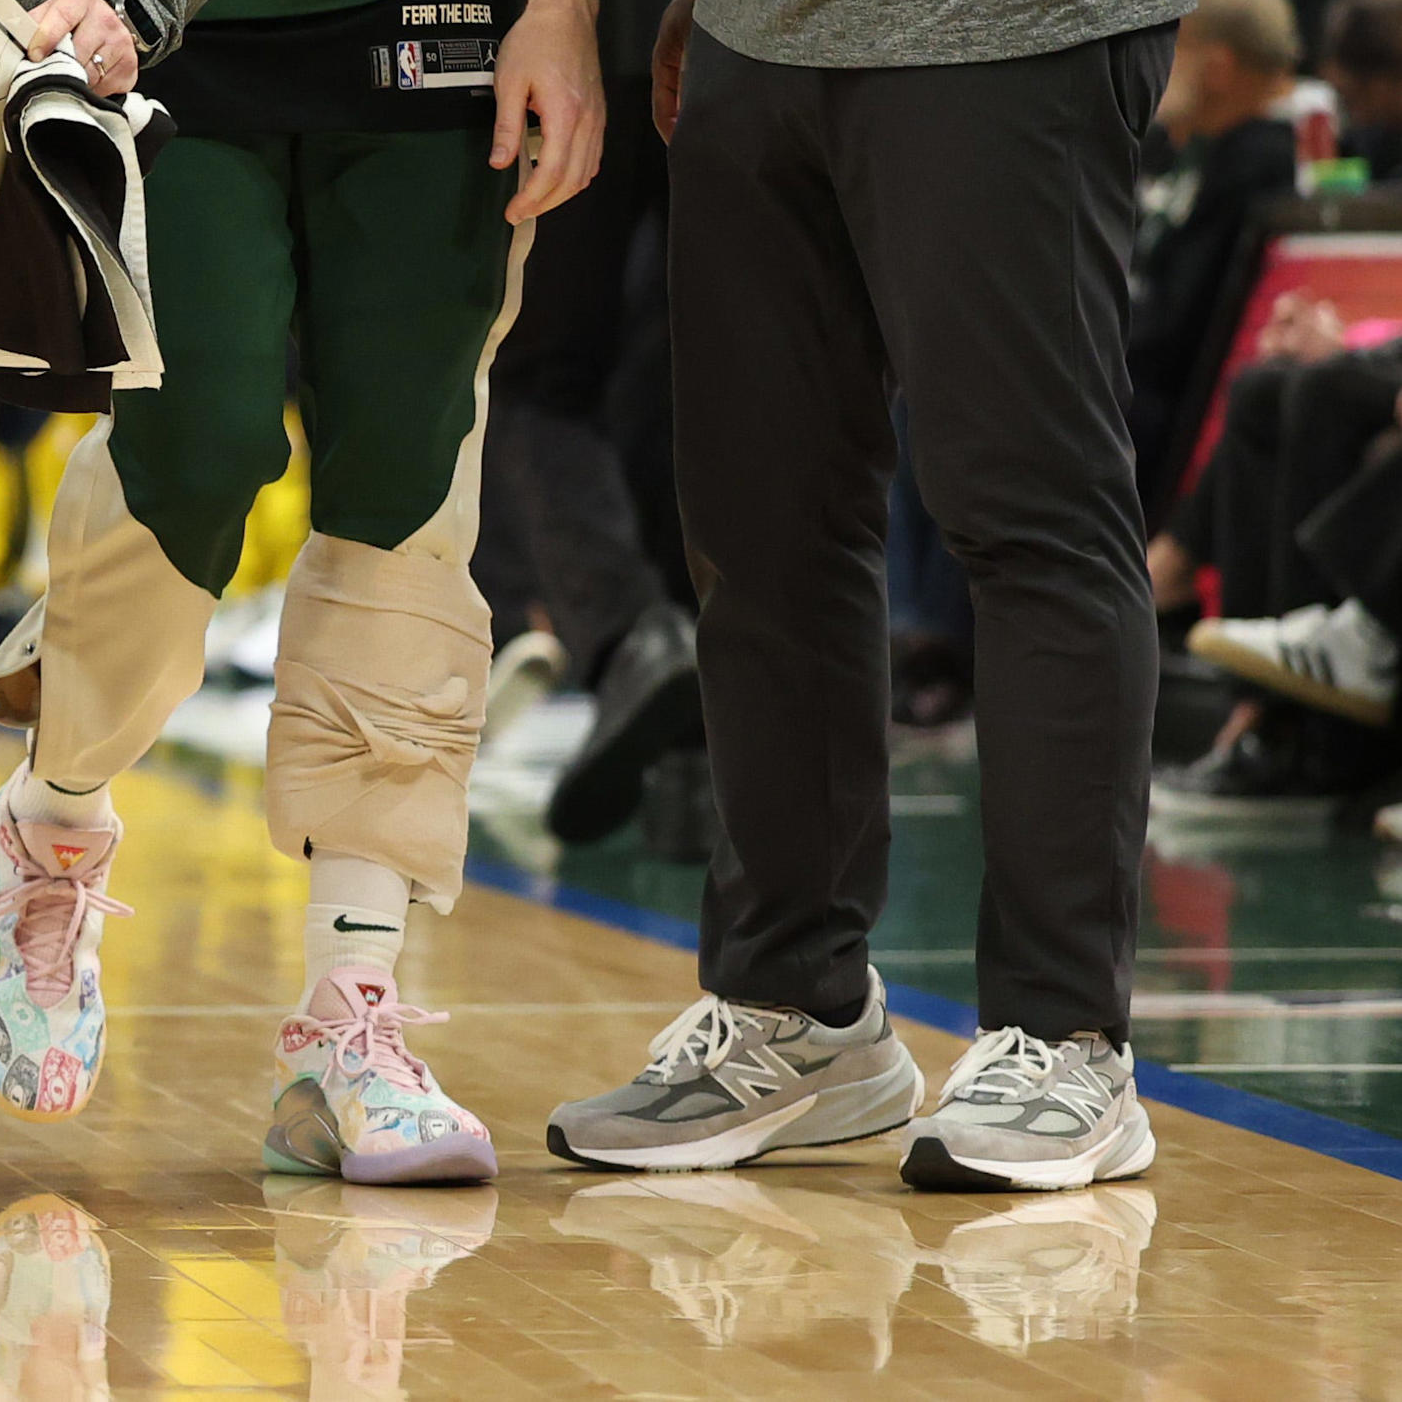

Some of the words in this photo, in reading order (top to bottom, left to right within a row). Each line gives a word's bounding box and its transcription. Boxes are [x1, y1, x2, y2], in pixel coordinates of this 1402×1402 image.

[402, 5, 437, 26] FEAR
[439, 3, 464, 24] THE
[464, 3, 492, 25] DEER
